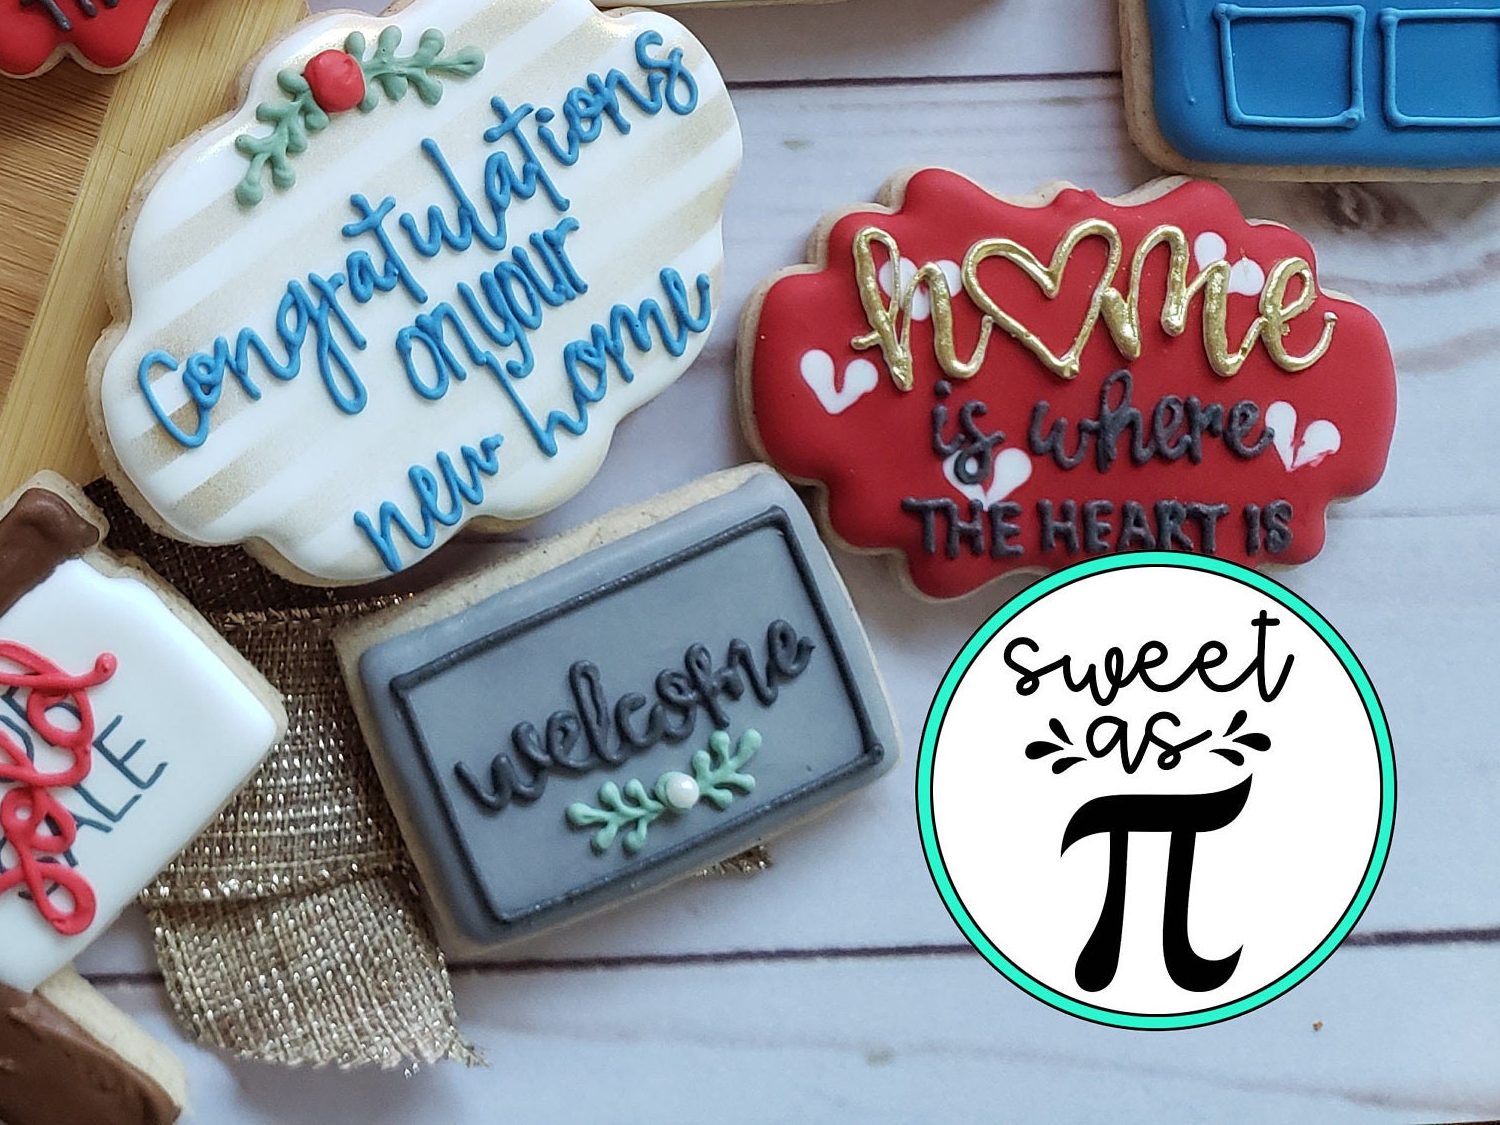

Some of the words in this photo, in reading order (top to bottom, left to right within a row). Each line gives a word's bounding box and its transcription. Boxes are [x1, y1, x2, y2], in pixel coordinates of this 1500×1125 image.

[354, 434, 504, 572] new
[481, 267, 711, 457] home
[932, 379, 1005, 485] is
[1028, 369, 1276, 472] where
[902, 497, 1024, 559] THE
[1037, 498, 1230, 556] HEART
[1244, 499, 1293, 556] IS
[454, 618, 816, 812] welcome
